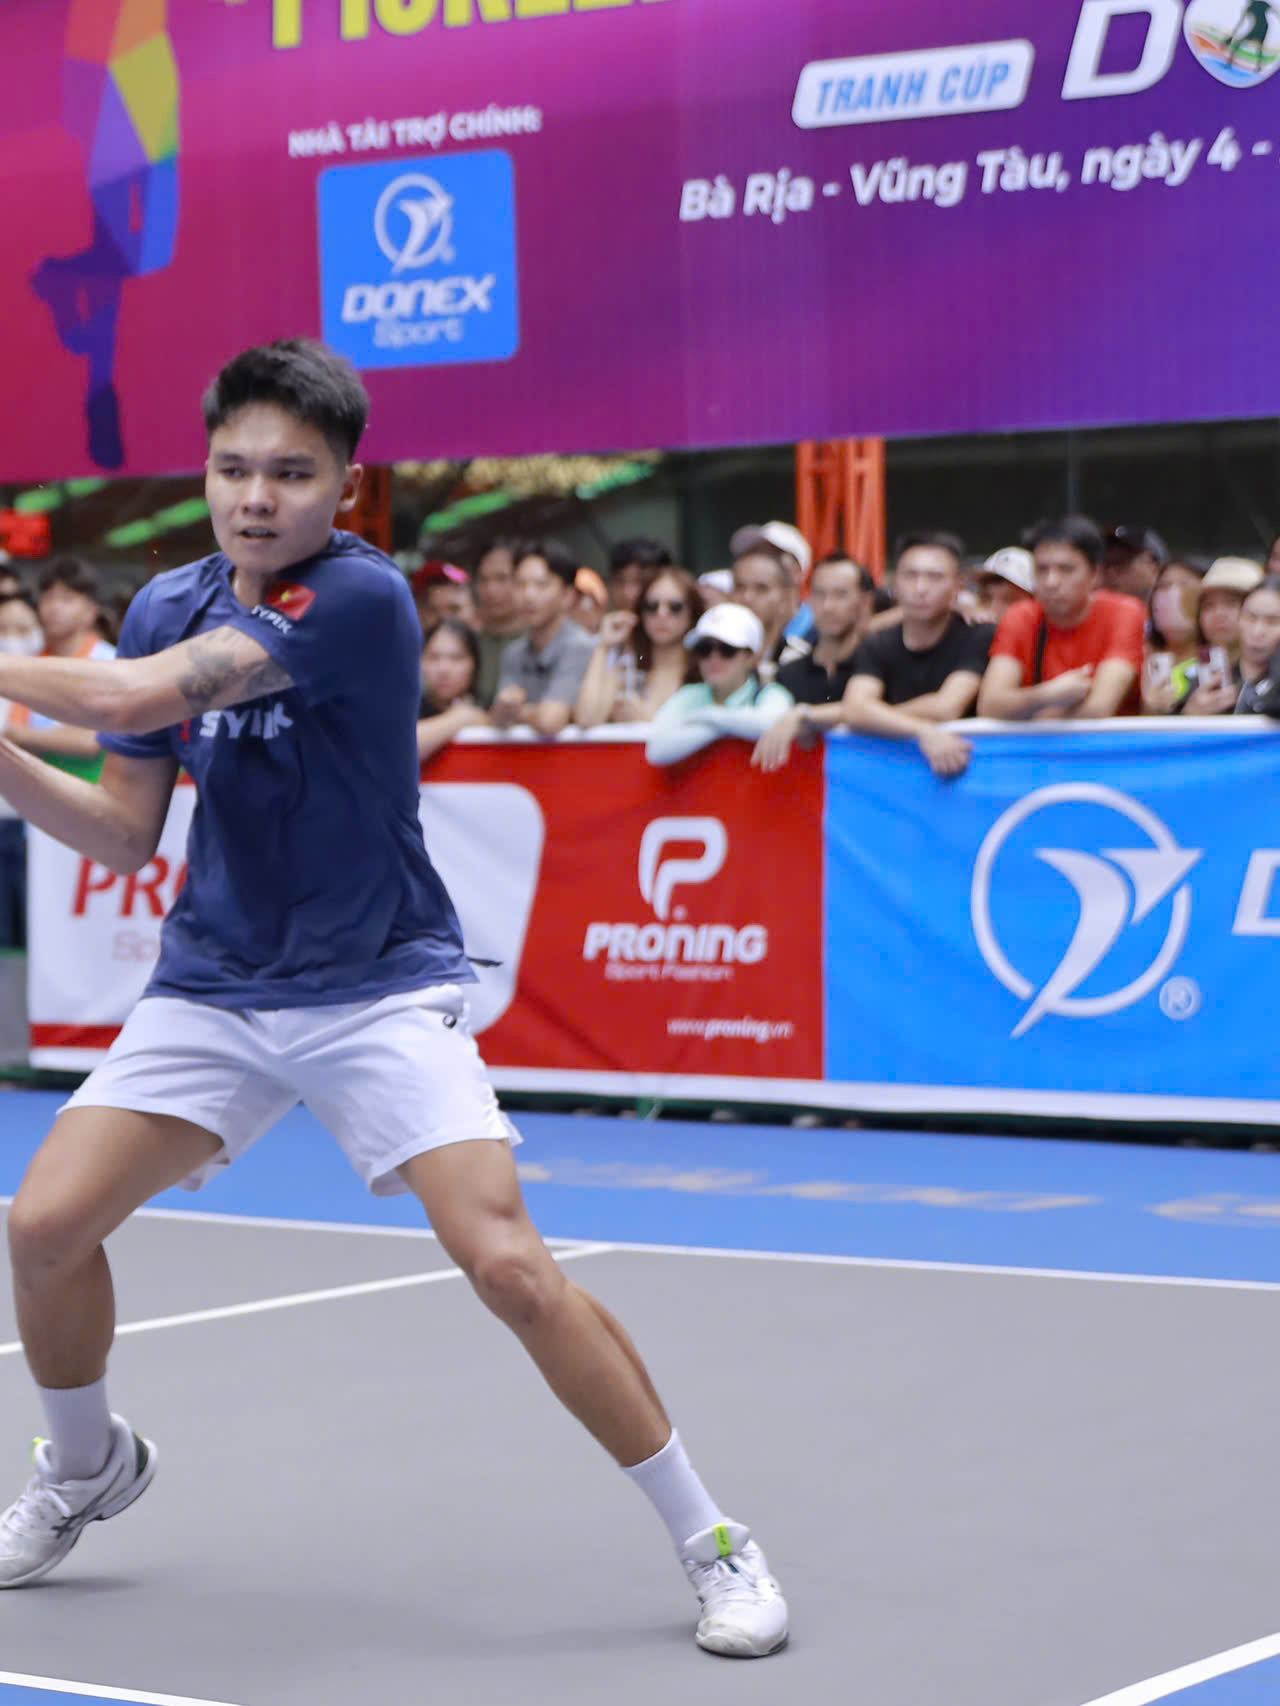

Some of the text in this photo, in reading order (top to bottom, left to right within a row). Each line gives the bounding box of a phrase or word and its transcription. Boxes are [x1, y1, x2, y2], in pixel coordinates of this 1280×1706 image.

[816, 52, 1012, 115] TRANH CÚP
[679, 173, 736, 222] Bà
[742, 166, 814, 225] Rịa
[850, 155, 968, 208] Vũng
[976, 144, 1070, 194] Tàu,
[1080, 130, 1204, 192] ngày
[1206, 125, 1243, 172] 4
[73, 855, 189, 917] PR
